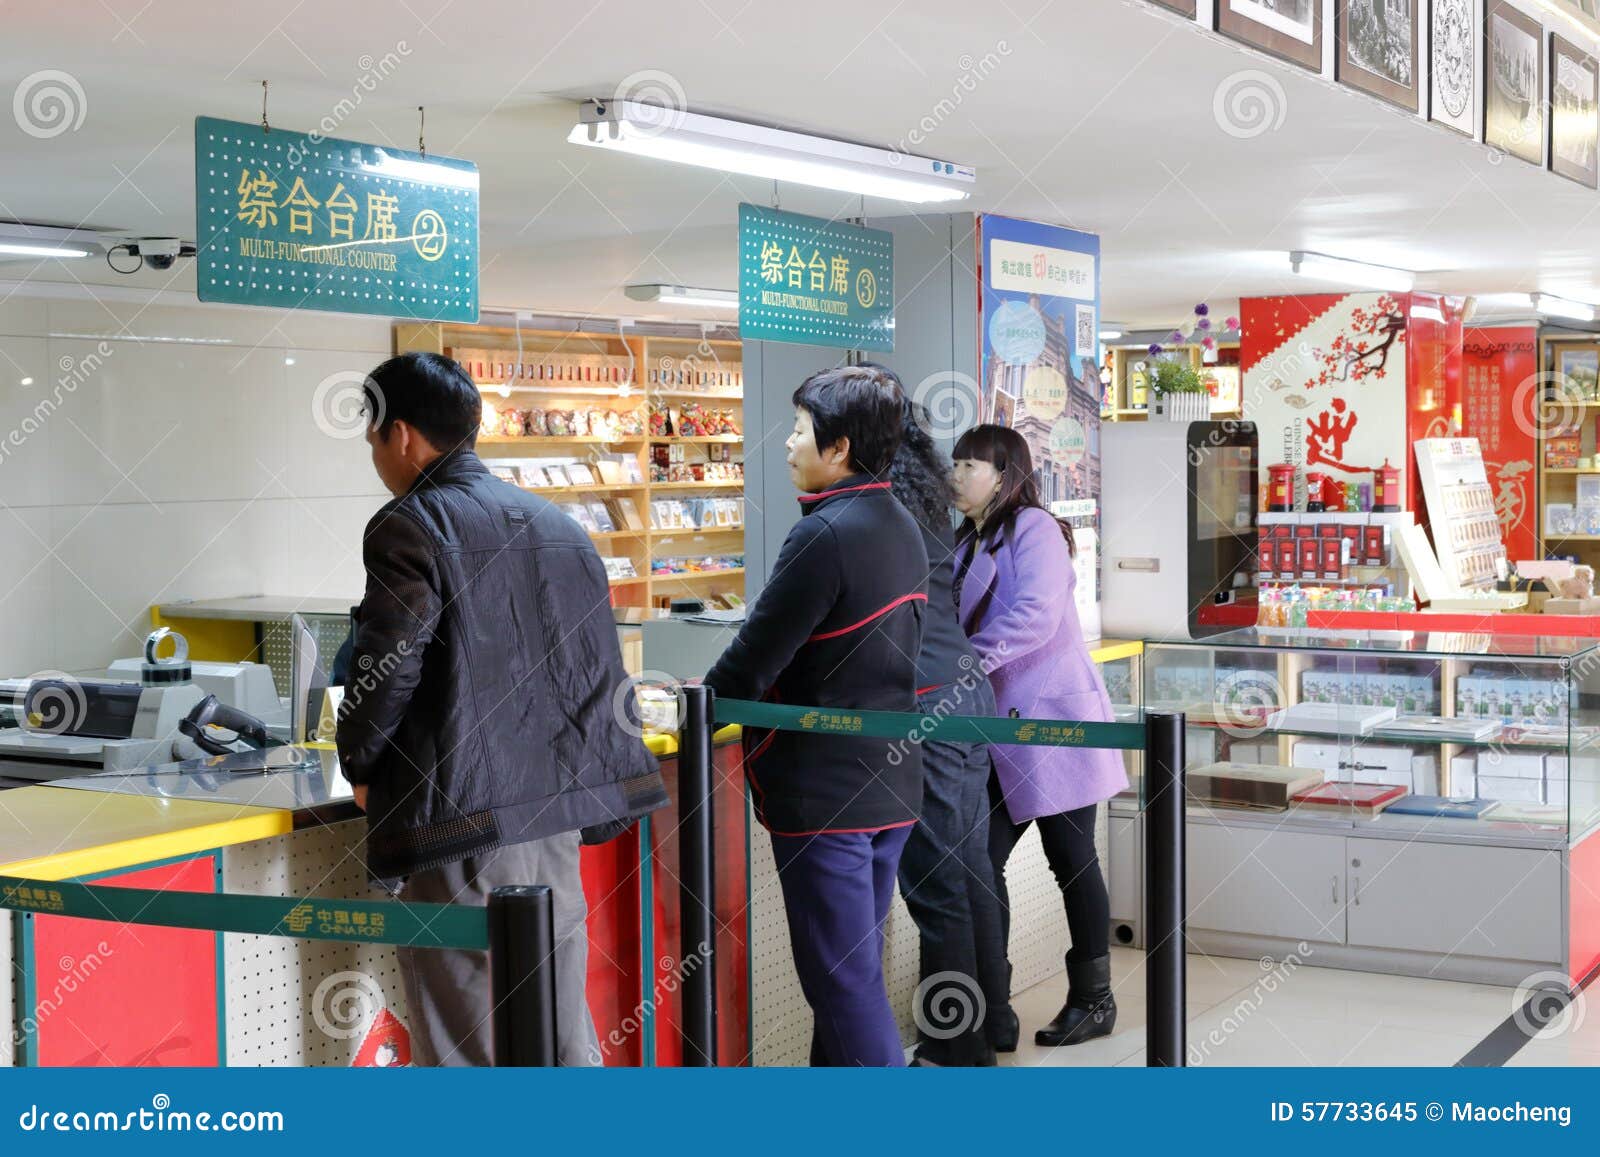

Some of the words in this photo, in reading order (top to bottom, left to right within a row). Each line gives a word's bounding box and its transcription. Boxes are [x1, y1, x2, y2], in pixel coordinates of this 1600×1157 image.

[236, 168, 400, 244] 综合台席
[239, 236, 346, 267] MULTI-FUNCTIONAL
[348, 251, 398, 272] COUNTER
[760, 240, 850, 296] 综合台席
[319, 922, 357, 935] CHINA
[358, 925, 385, 937] POST
